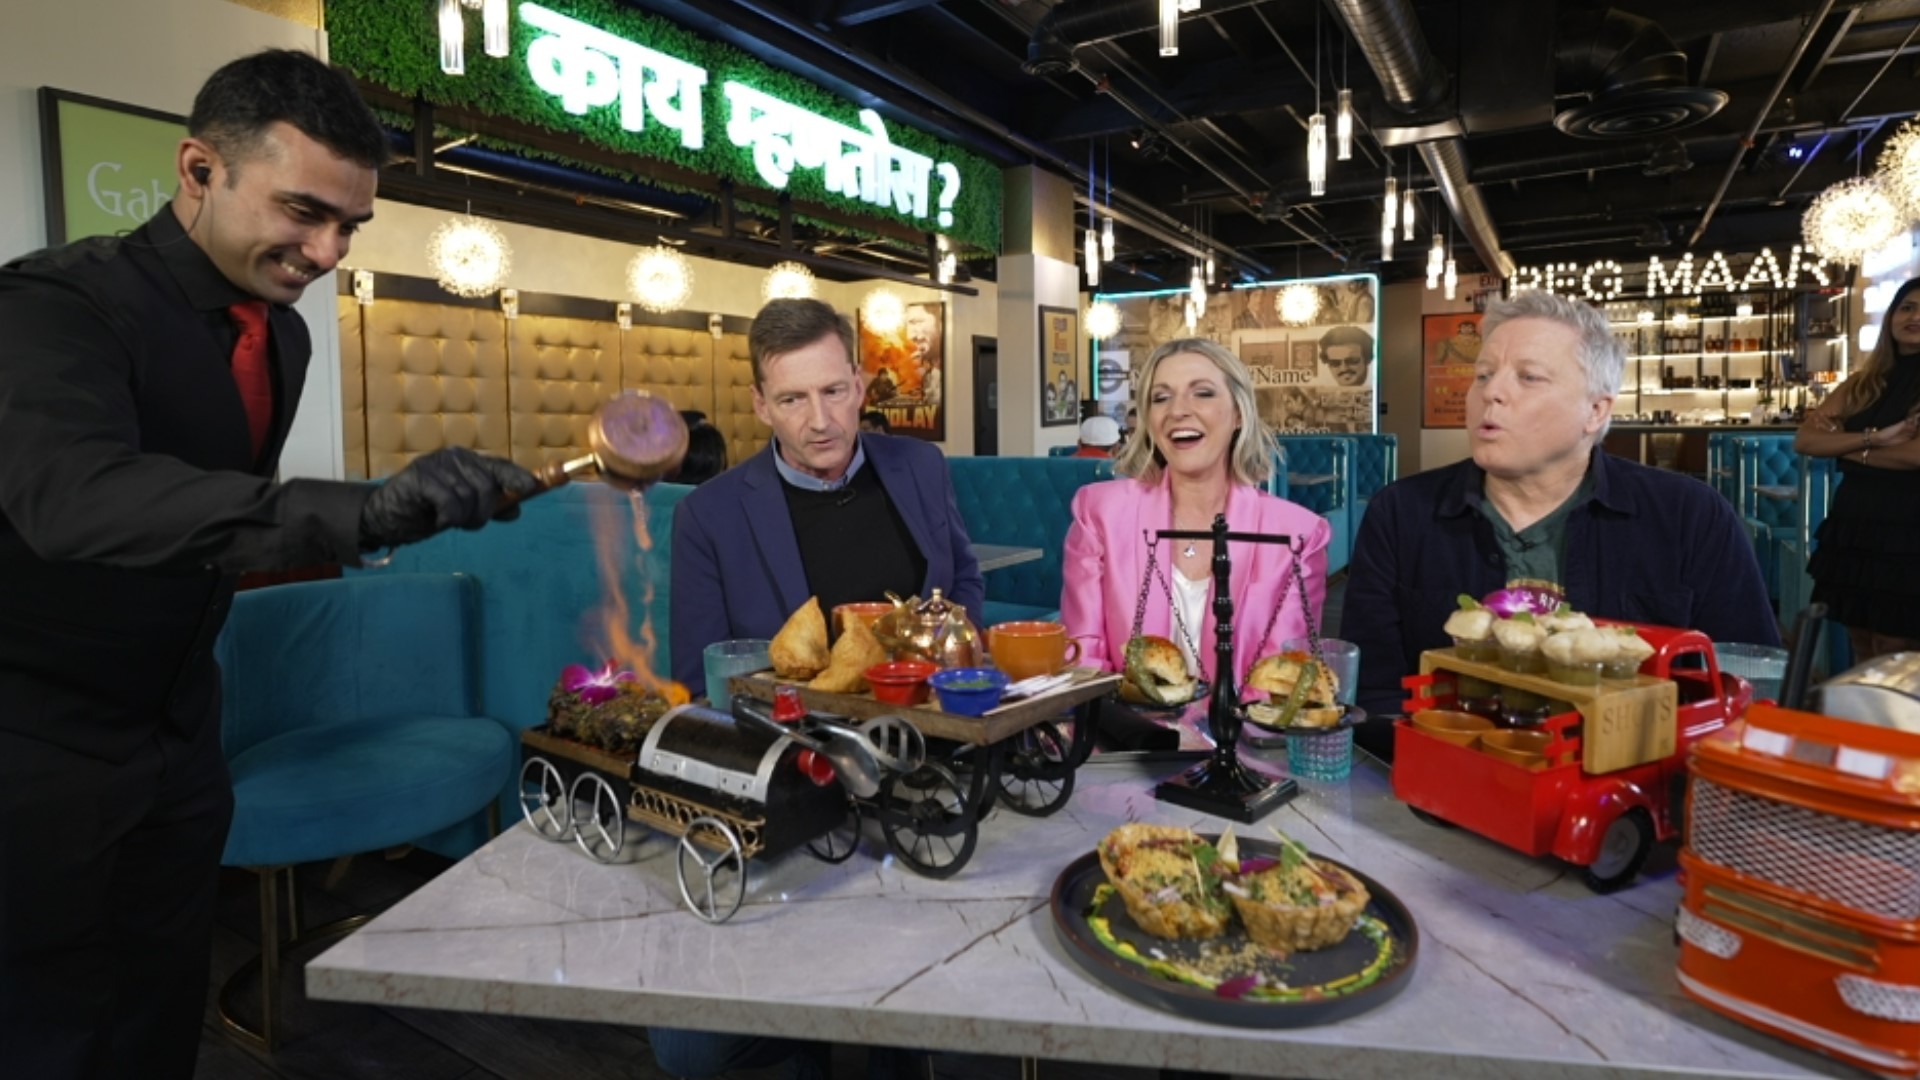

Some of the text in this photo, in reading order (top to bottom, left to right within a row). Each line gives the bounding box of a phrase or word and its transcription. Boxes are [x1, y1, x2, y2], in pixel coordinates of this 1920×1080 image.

[519, 2, 708, 150] काय
[1648, 245, 1830, 297] MAAR
[1602, 694, 1672, 735] SHOS
